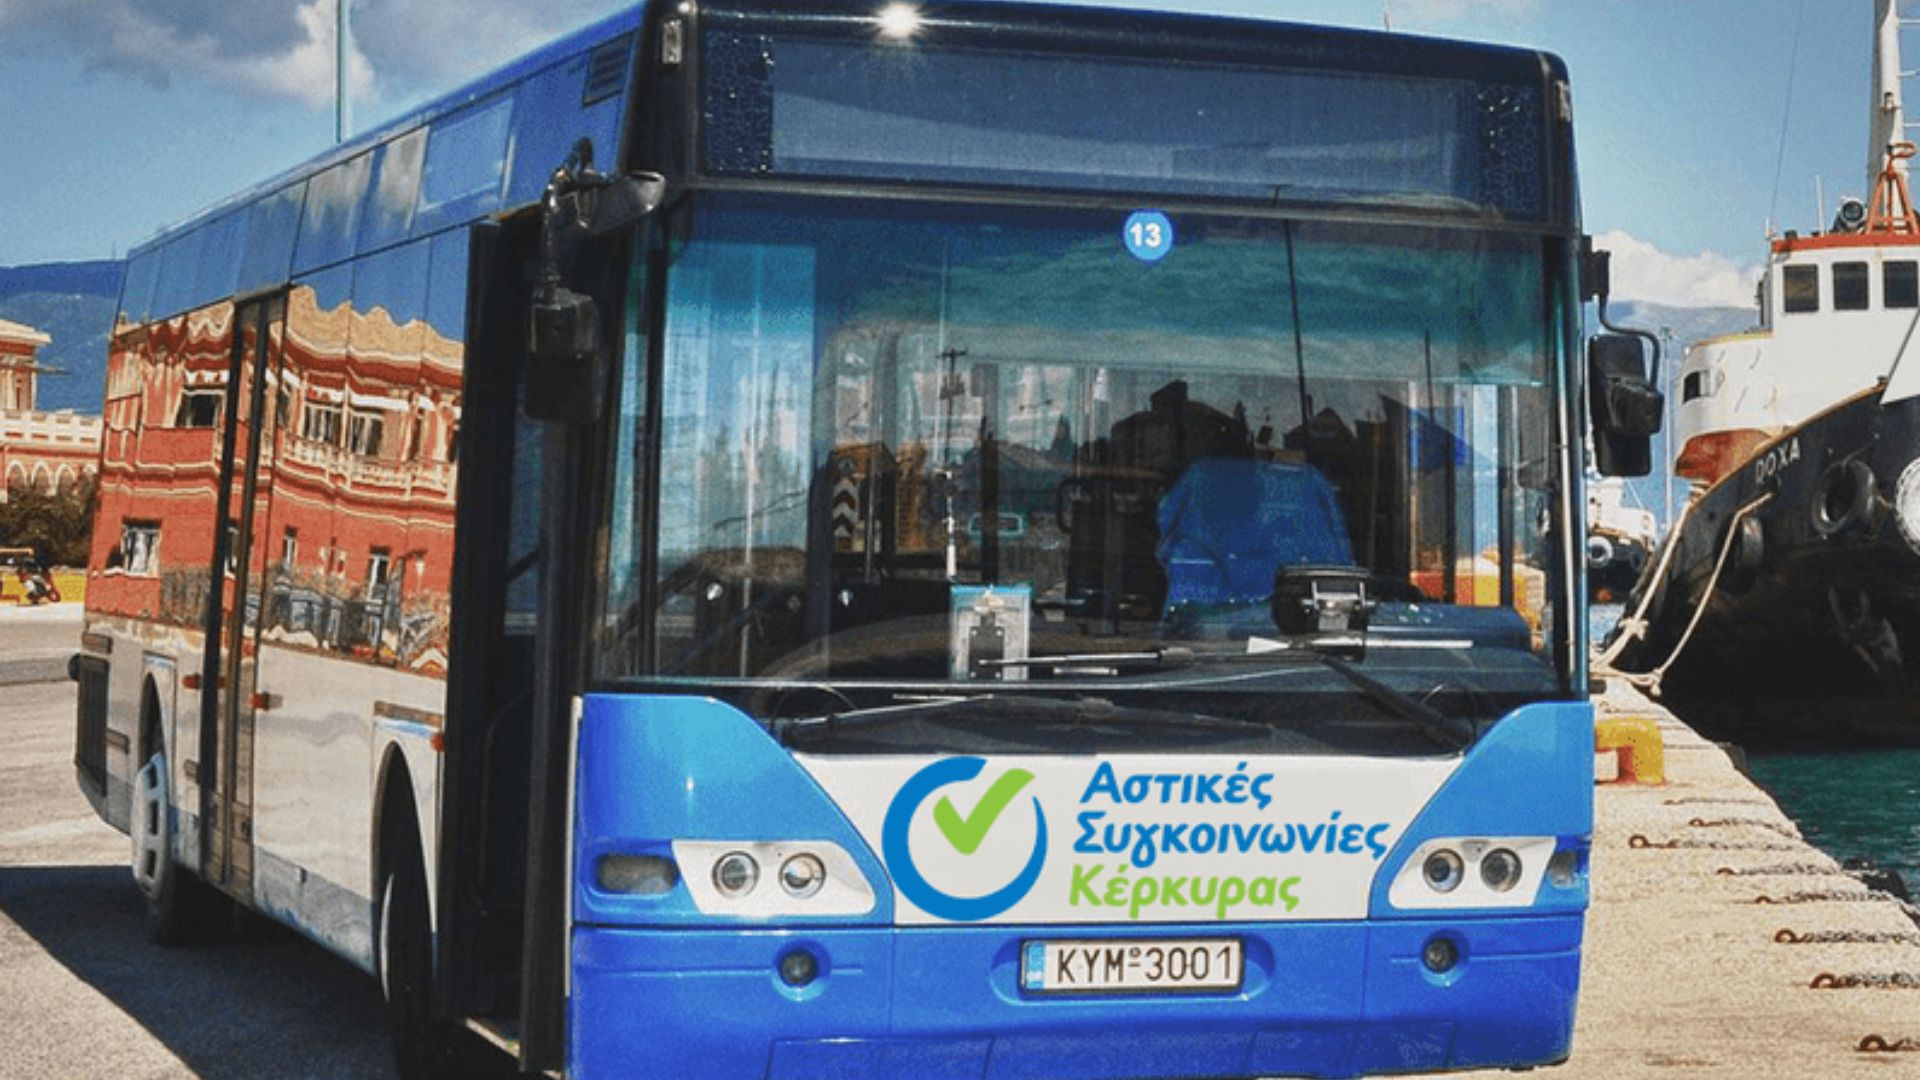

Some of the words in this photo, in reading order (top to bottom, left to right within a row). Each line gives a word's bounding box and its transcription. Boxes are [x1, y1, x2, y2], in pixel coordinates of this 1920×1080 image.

[1130, 222, 1162, 248] 13
[1079, 761, 1275, 811] Αστικές
[1072, 810, 1390, 869] Συγκοινωνίες
[1069, 863, 1302, 920] Κέρκυρας
